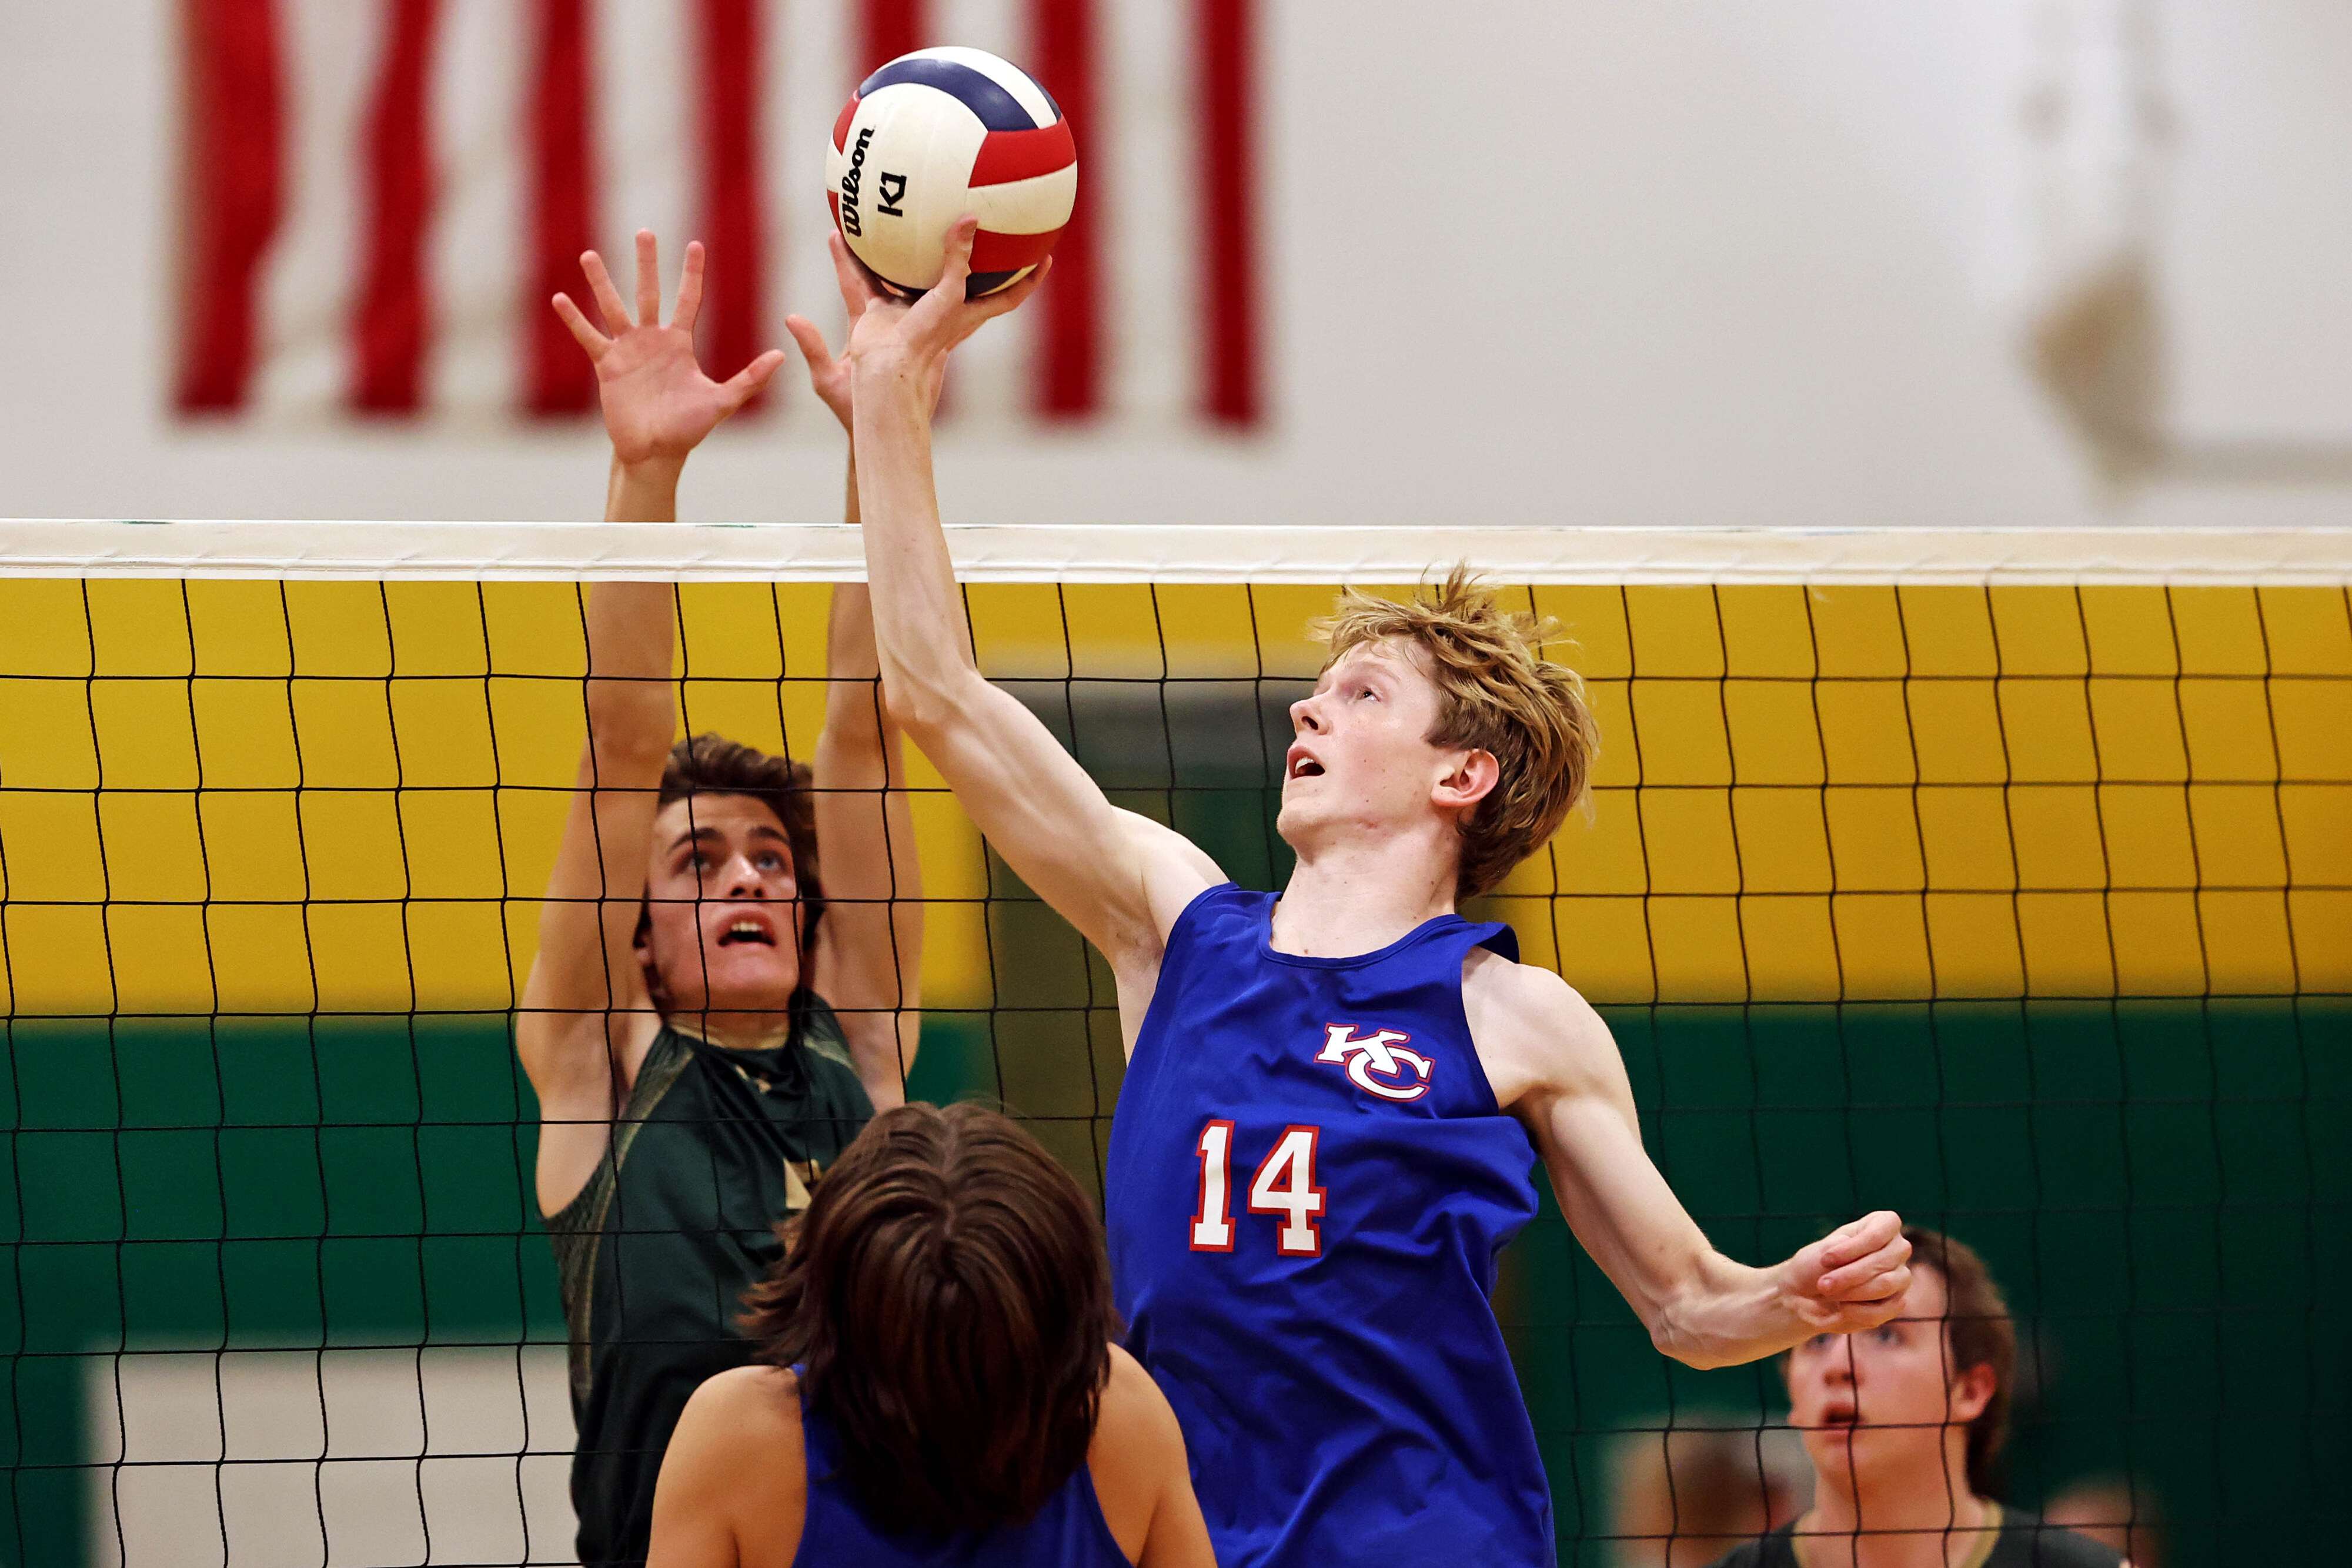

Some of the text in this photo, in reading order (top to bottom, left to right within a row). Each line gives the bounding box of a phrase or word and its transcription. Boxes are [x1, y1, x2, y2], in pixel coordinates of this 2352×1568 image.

[841, 128, 875, 237] Wilson
[878, 172, 907, 217] K1
[1314, 1023, 1435, 1101] KC
[1189, 1119, 1327, 1257] 14
